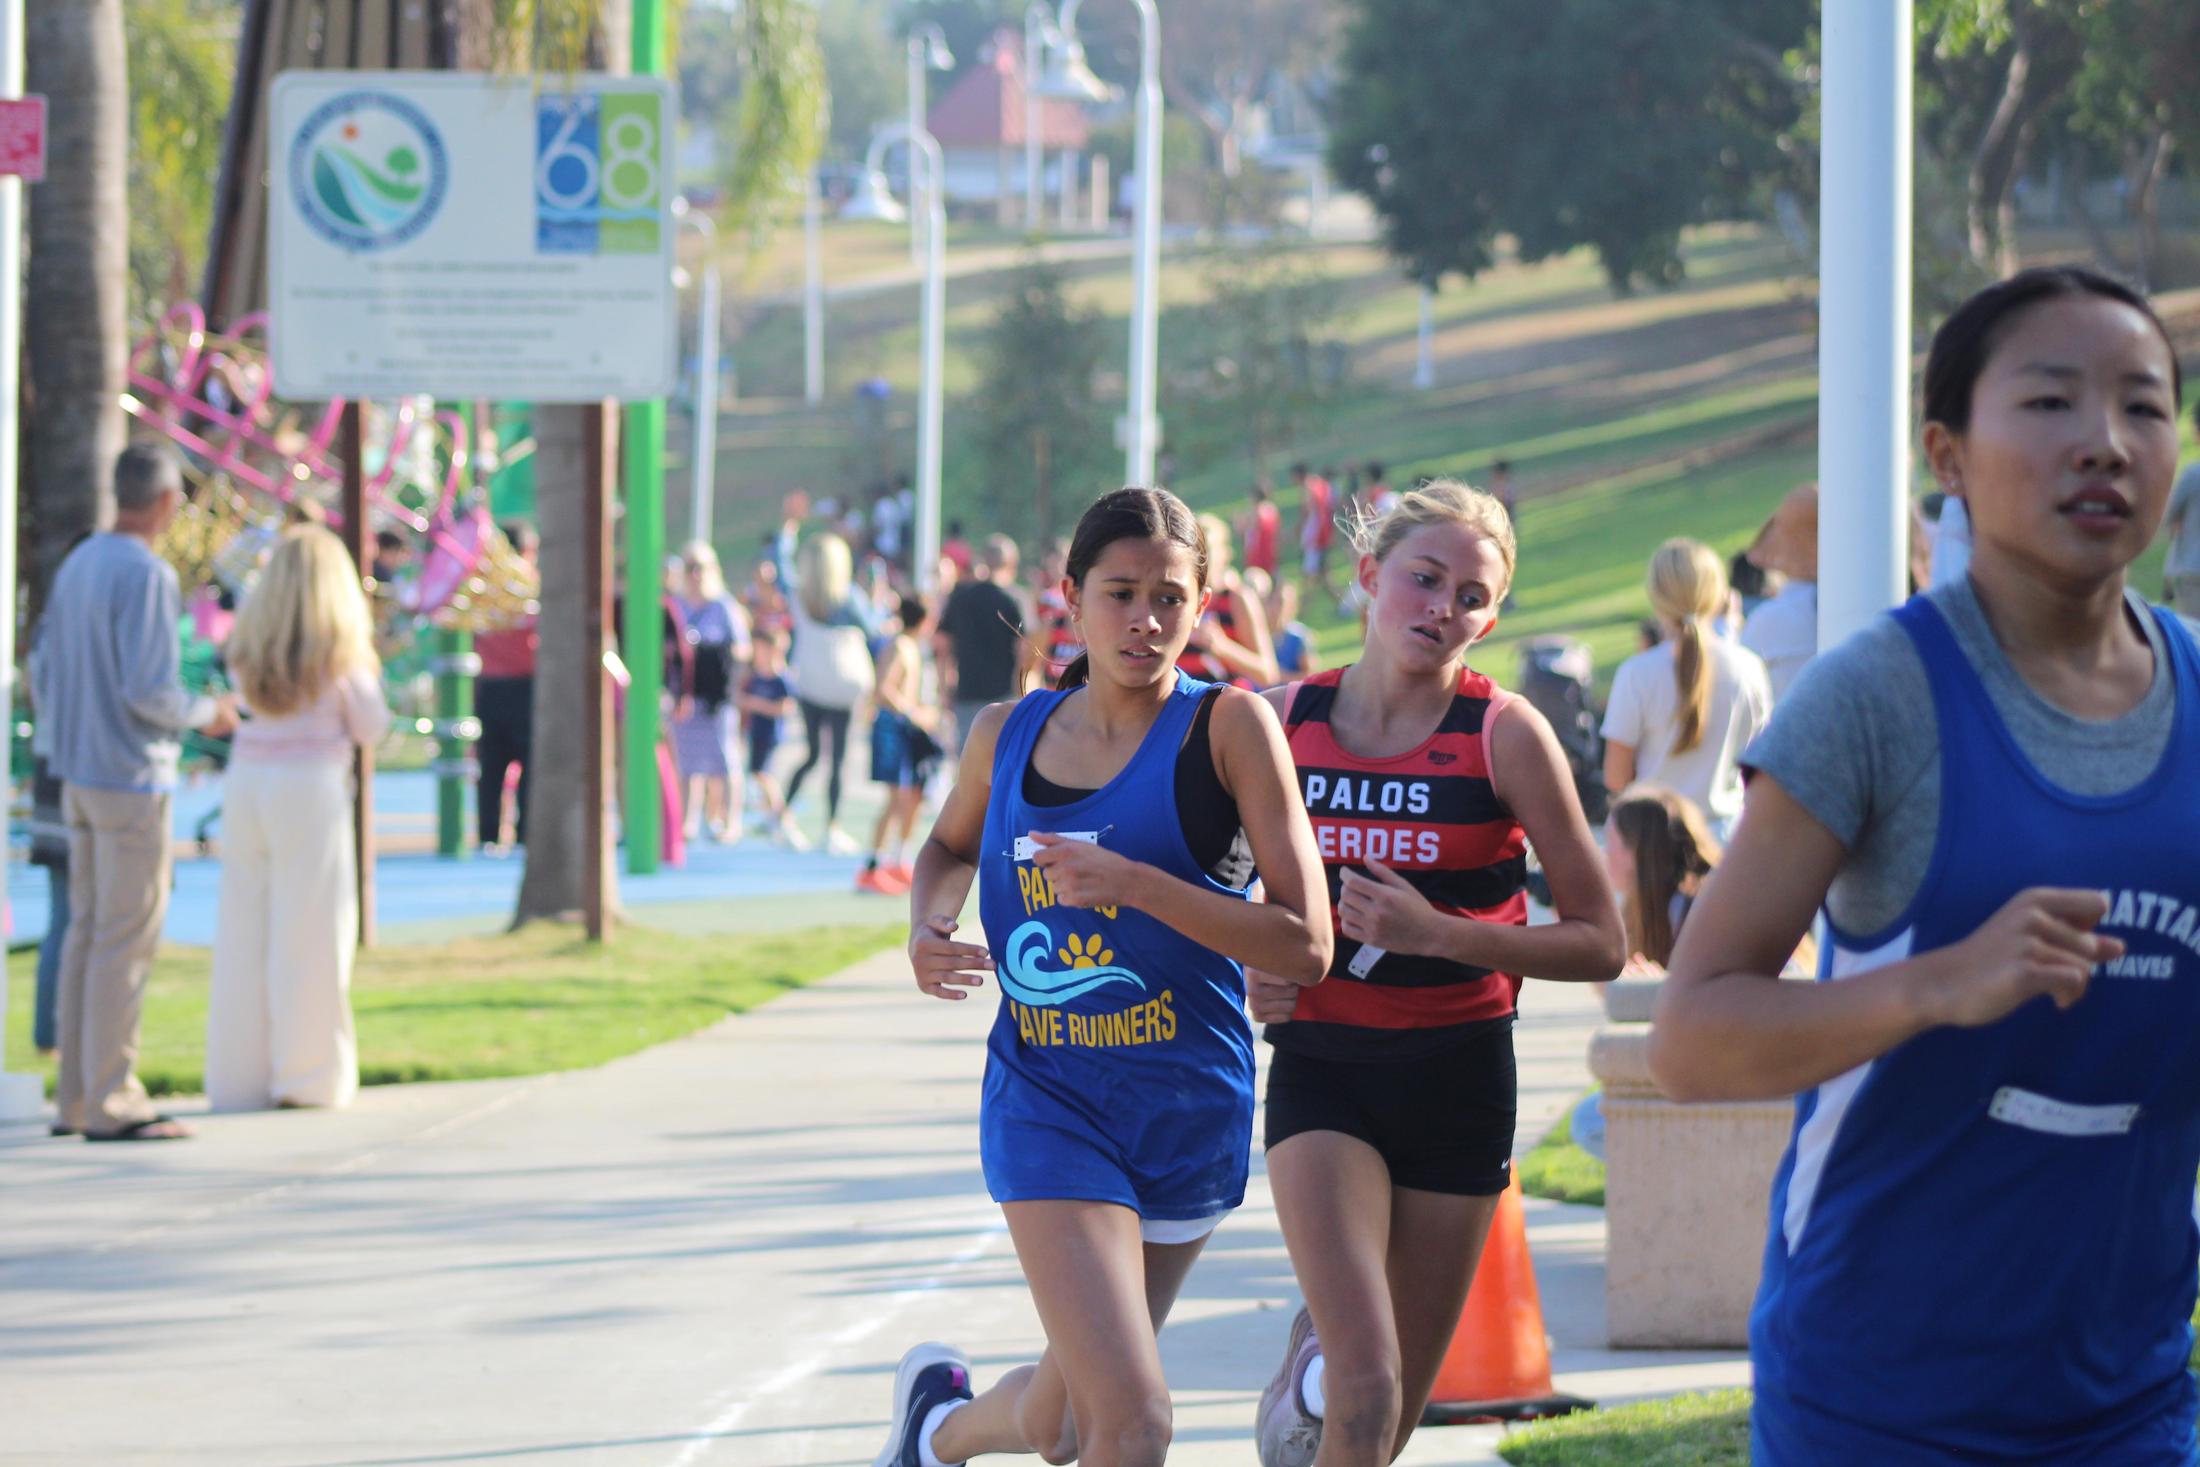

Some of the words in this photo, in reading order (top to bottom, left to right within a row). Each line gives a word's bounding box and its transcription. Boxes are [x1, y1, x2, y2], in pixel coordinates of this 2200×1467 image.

[537, 95, 660, 209] 68
[1305, 775, 1431, 814] PALOS
[1316, 825, 1441, 864] ERDES
[2105, 955, 2174, 979] WAVES
[1067, 988, 1177, 1048] RUNNERS
